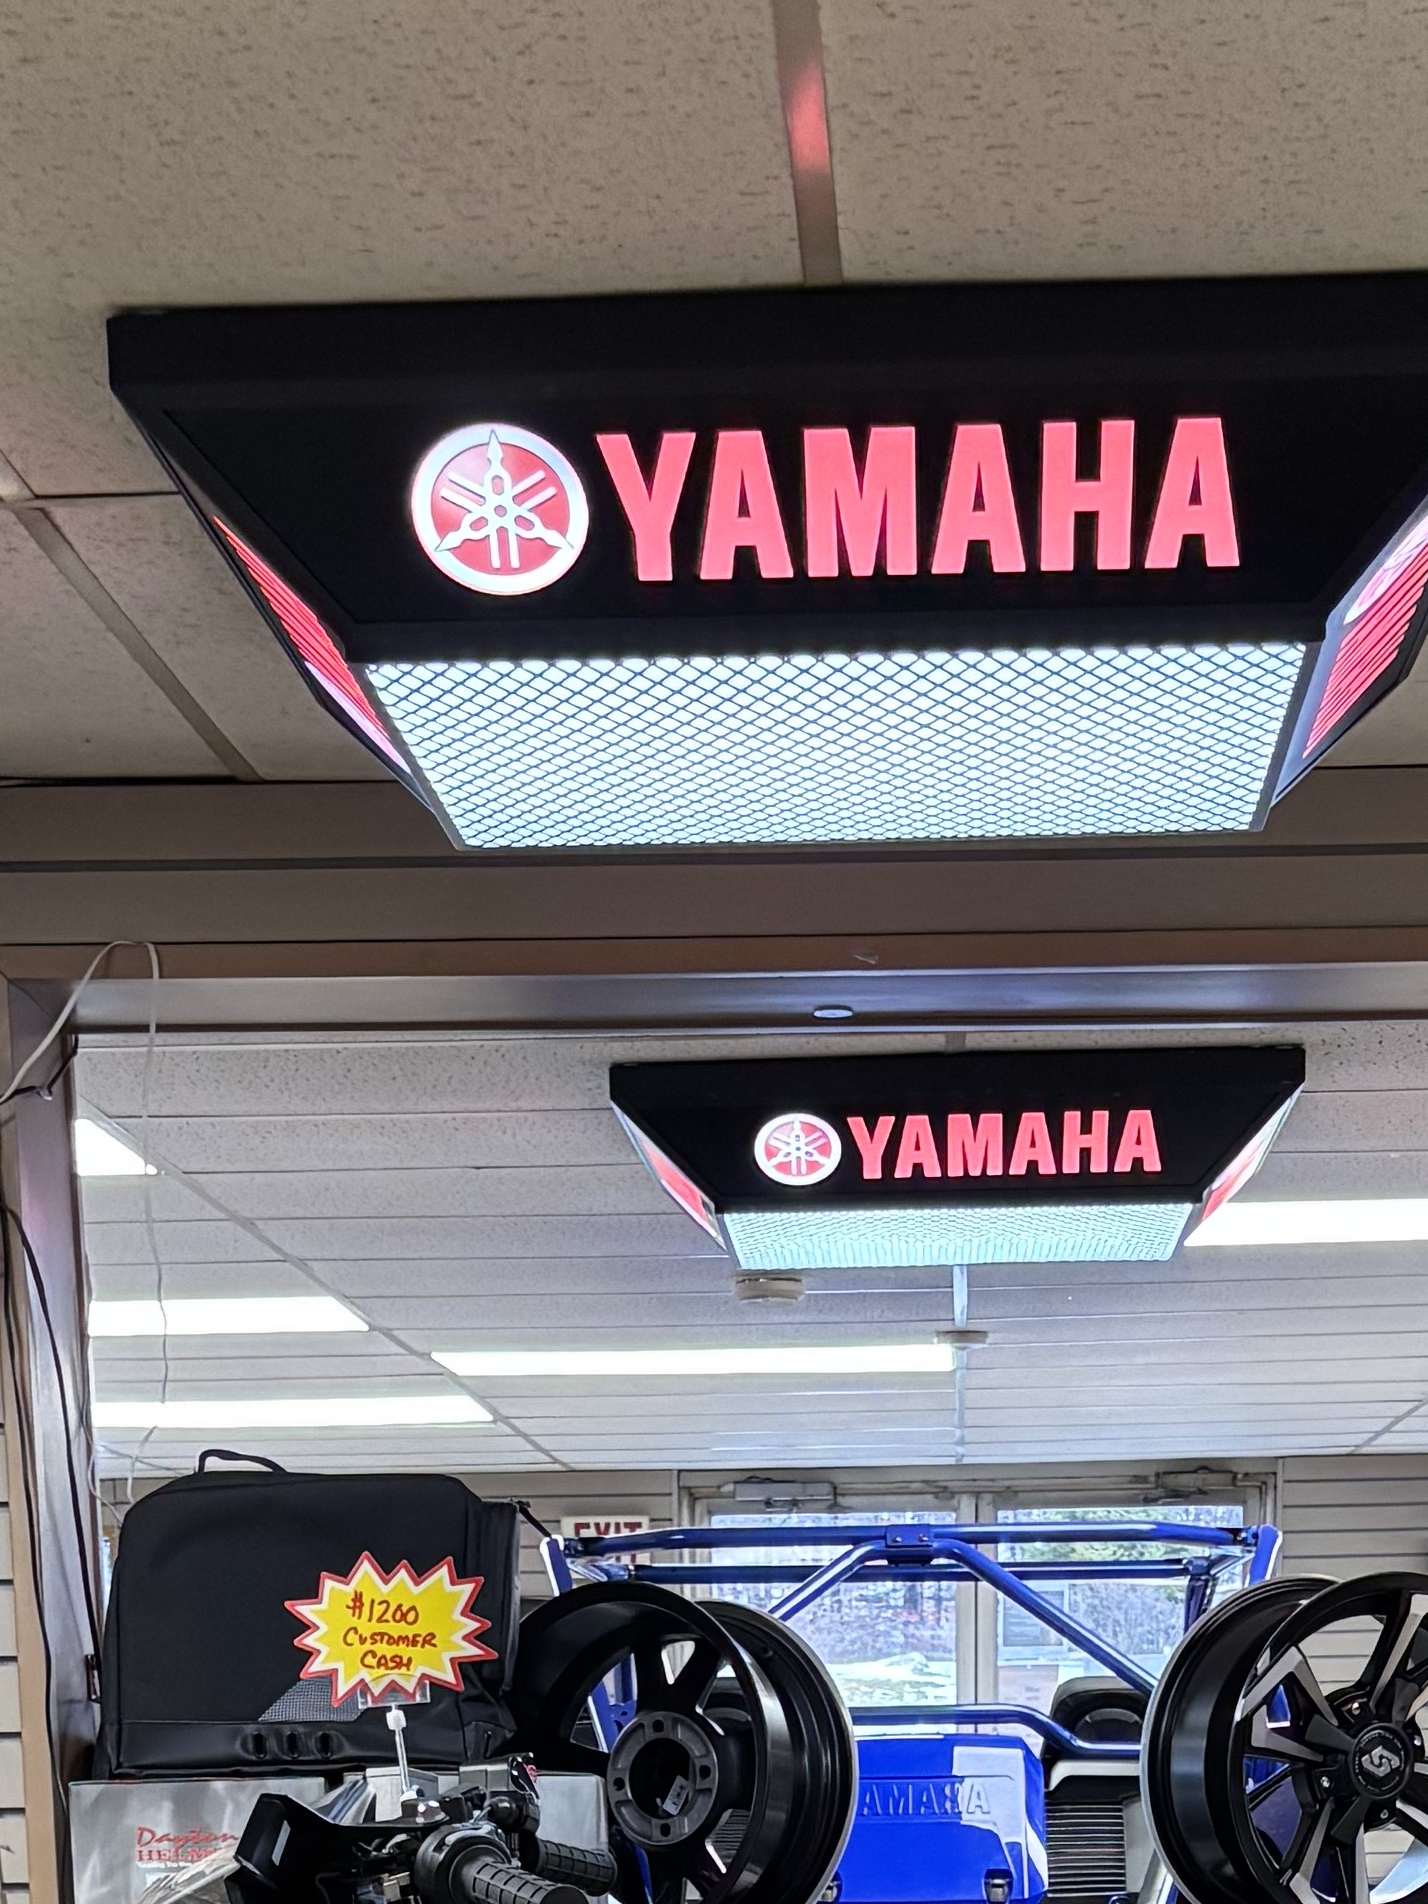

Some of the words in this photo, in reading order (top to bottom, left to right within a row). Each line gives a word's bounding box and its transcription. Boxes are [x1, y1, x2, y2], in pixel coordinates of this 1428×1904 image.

[595, 415, 1241, 583] YAMAHA
[846, 1109, 1162, 1181] YAMAHA
[863, 1783, 990, 1816] AMAHA
[136, 1827, 240, 1852] Dayton
